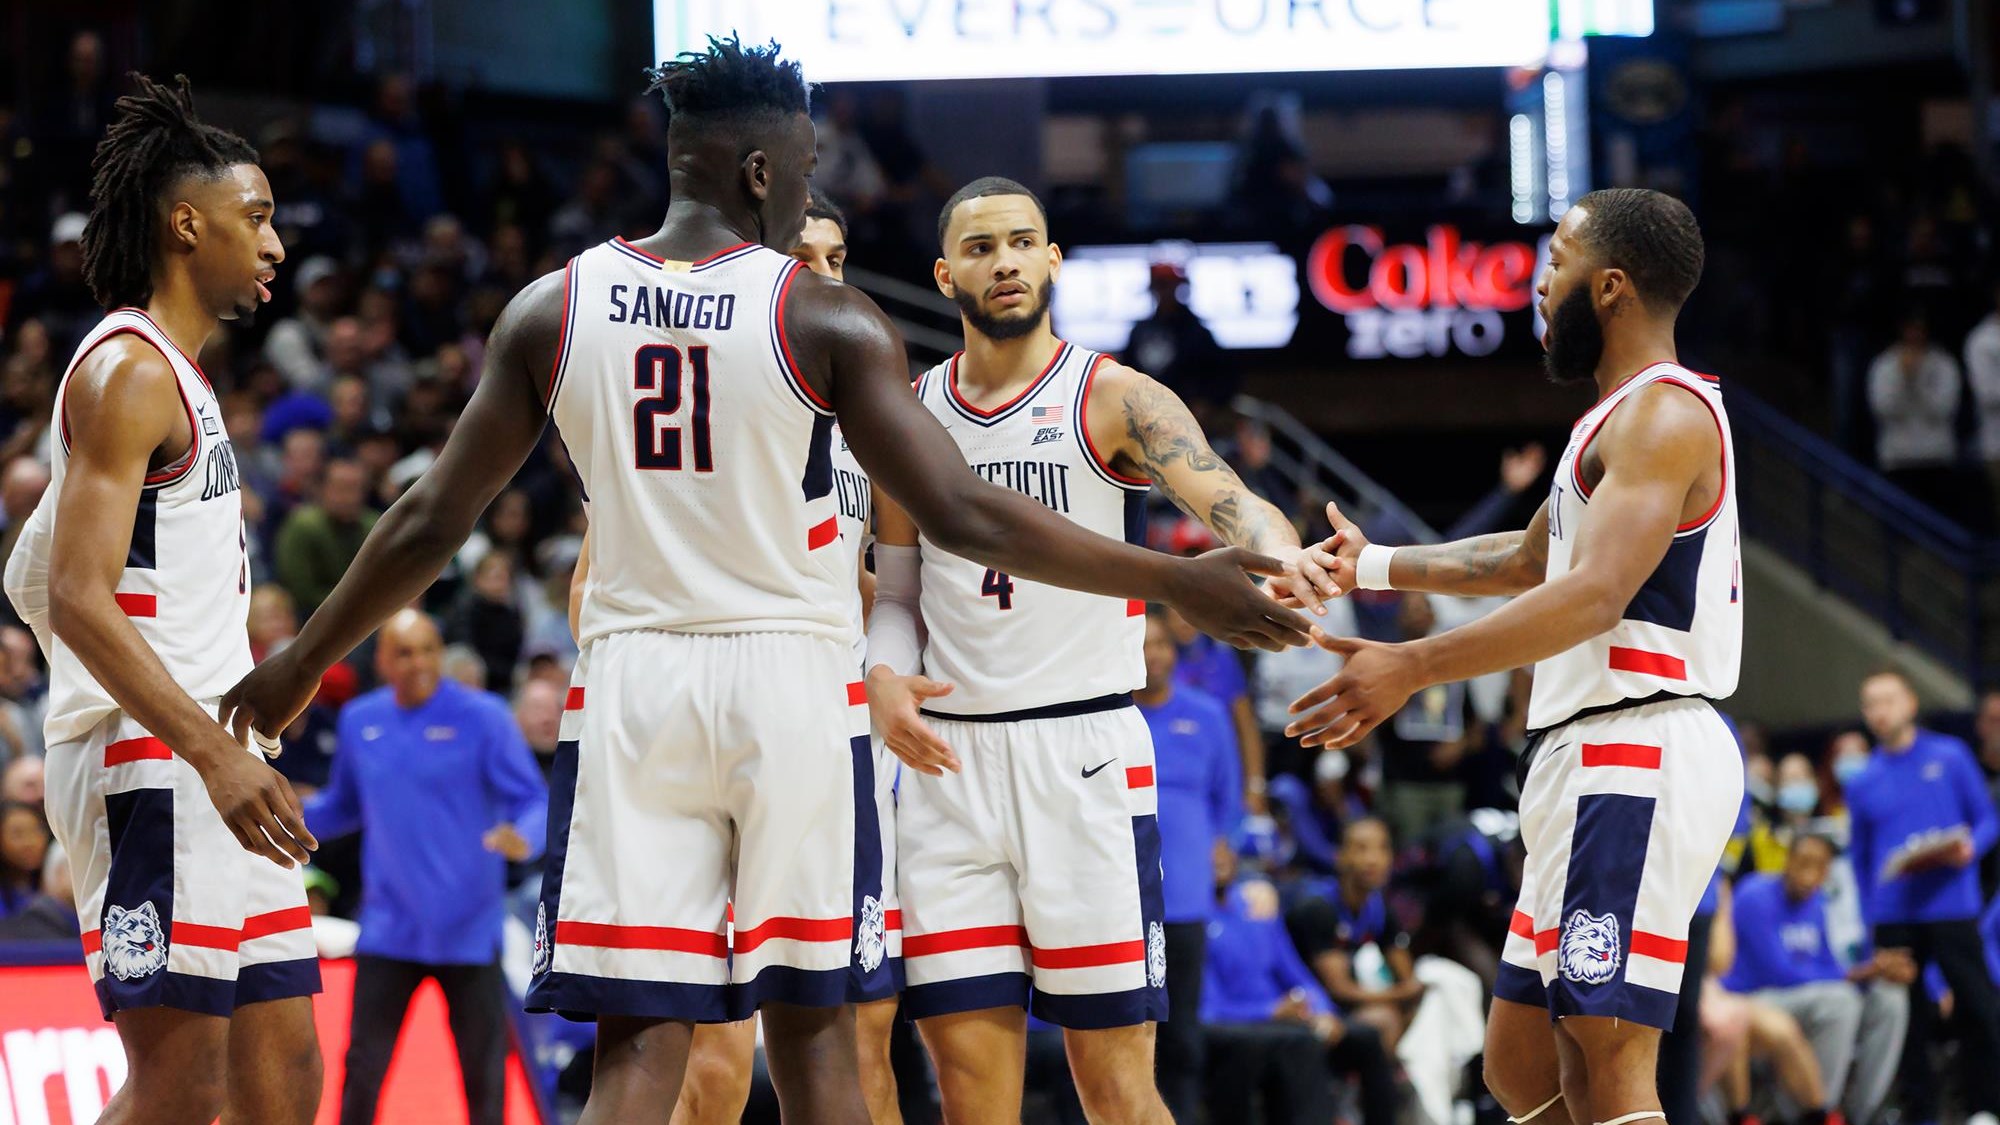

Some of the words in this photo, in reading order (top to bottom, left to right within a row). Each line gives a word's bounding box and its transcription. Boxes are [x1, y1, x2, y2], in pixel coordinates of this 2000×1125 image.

[1306, 224, 1535, 314] Coke
[609, 284, 735, 331] SANOGO
[1345, 308, 1505, 358] zero
[634, 343, 713, 473] 21
[1037, 427, 1059, 436] BIG
[1033, 432, 1065, 442] EAST
[970, 460, 1069, 513] TICUT
[981, 566, 1014, 610] 4
